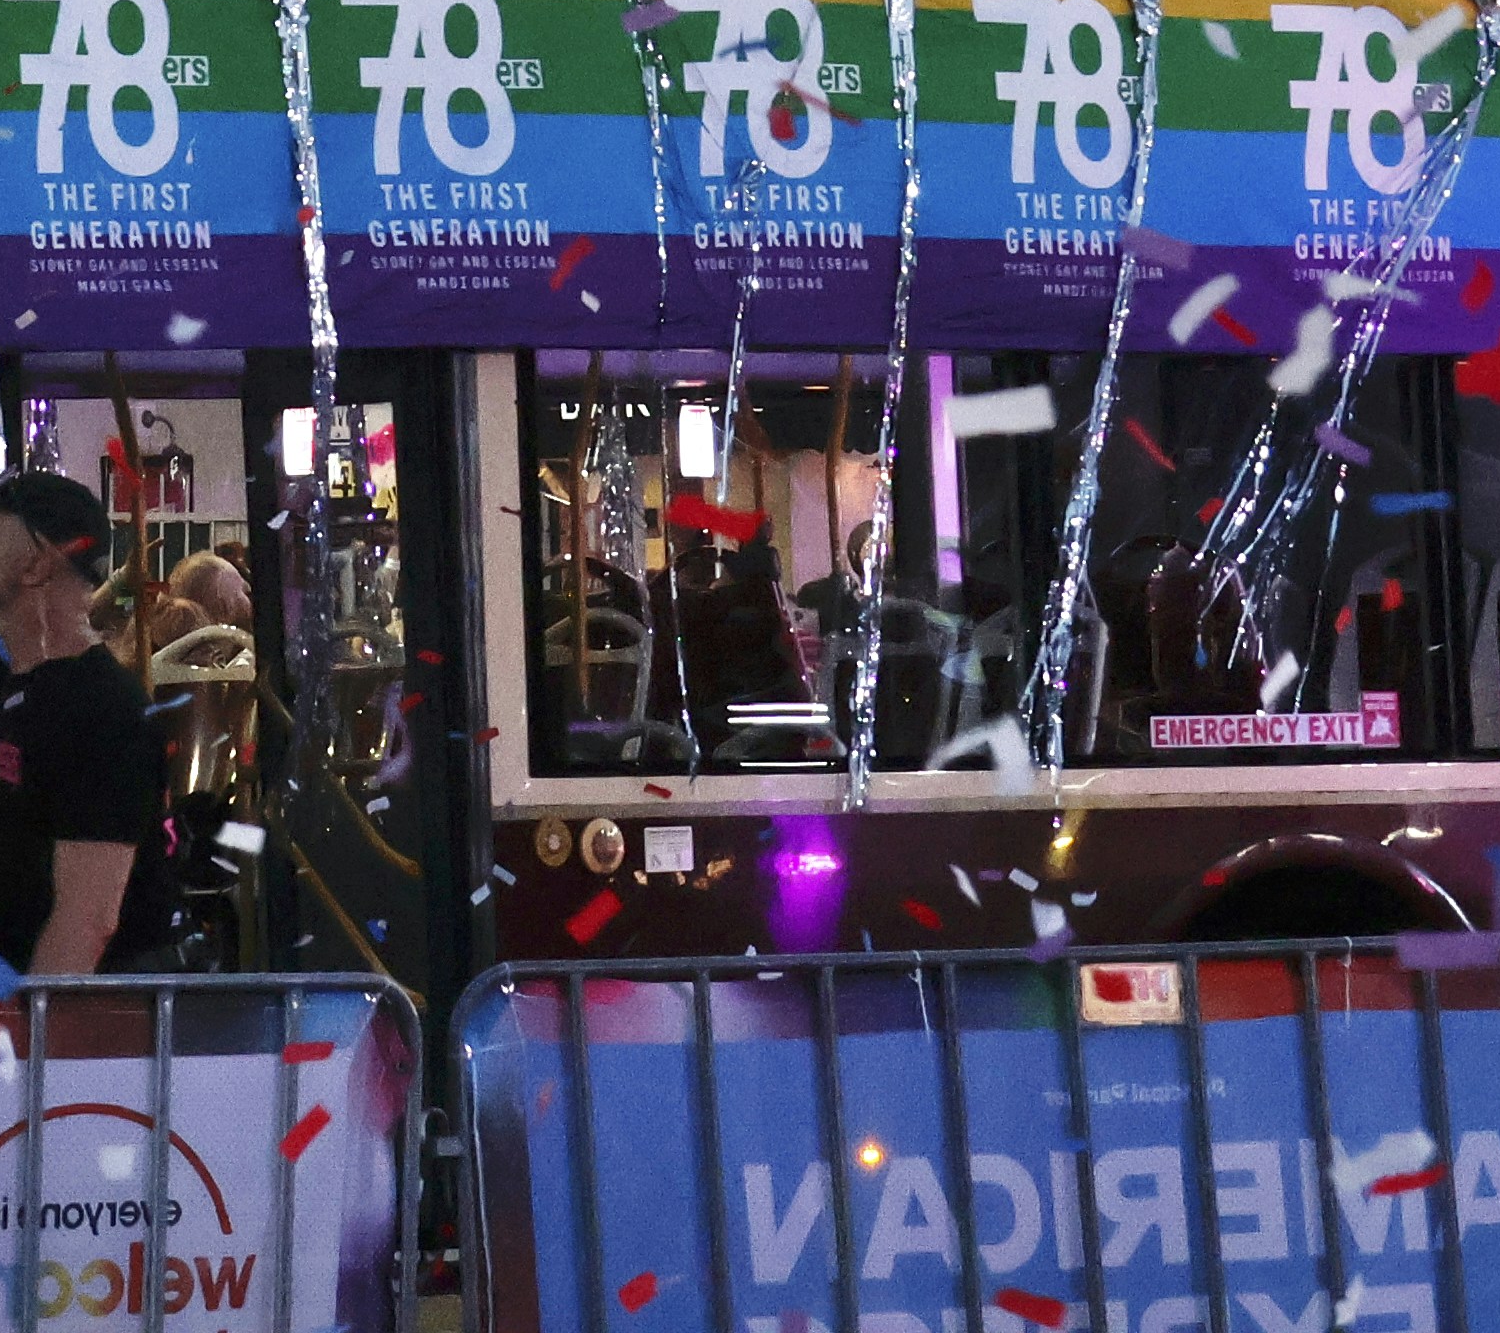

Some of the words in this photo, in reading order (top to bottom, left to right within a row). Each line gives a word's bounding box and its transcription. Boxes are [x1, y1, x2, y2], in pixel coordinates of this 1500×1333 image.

[43, 183, 98, 212] THE
[110, 183, 192, 212] FIRST
[379, 183, 437, 212] THE
[449, 183, 529, 211] FIRST
[767, 184, 845, 213] FIRST
[1015, 192, 1065, 220] THE
[1074, 194, 1129, 223] FIRS
[1308, 198, 1356, 226] THE
[30, 220, 212, 251] GENERATION
[367, 218, 551, 248] GENERATION
[1005, 226, 1116, 257] GENERAT
[1153, 716, 1299, 746] EMERGENCY
[1308, 714, 1361, 744] EXIT
